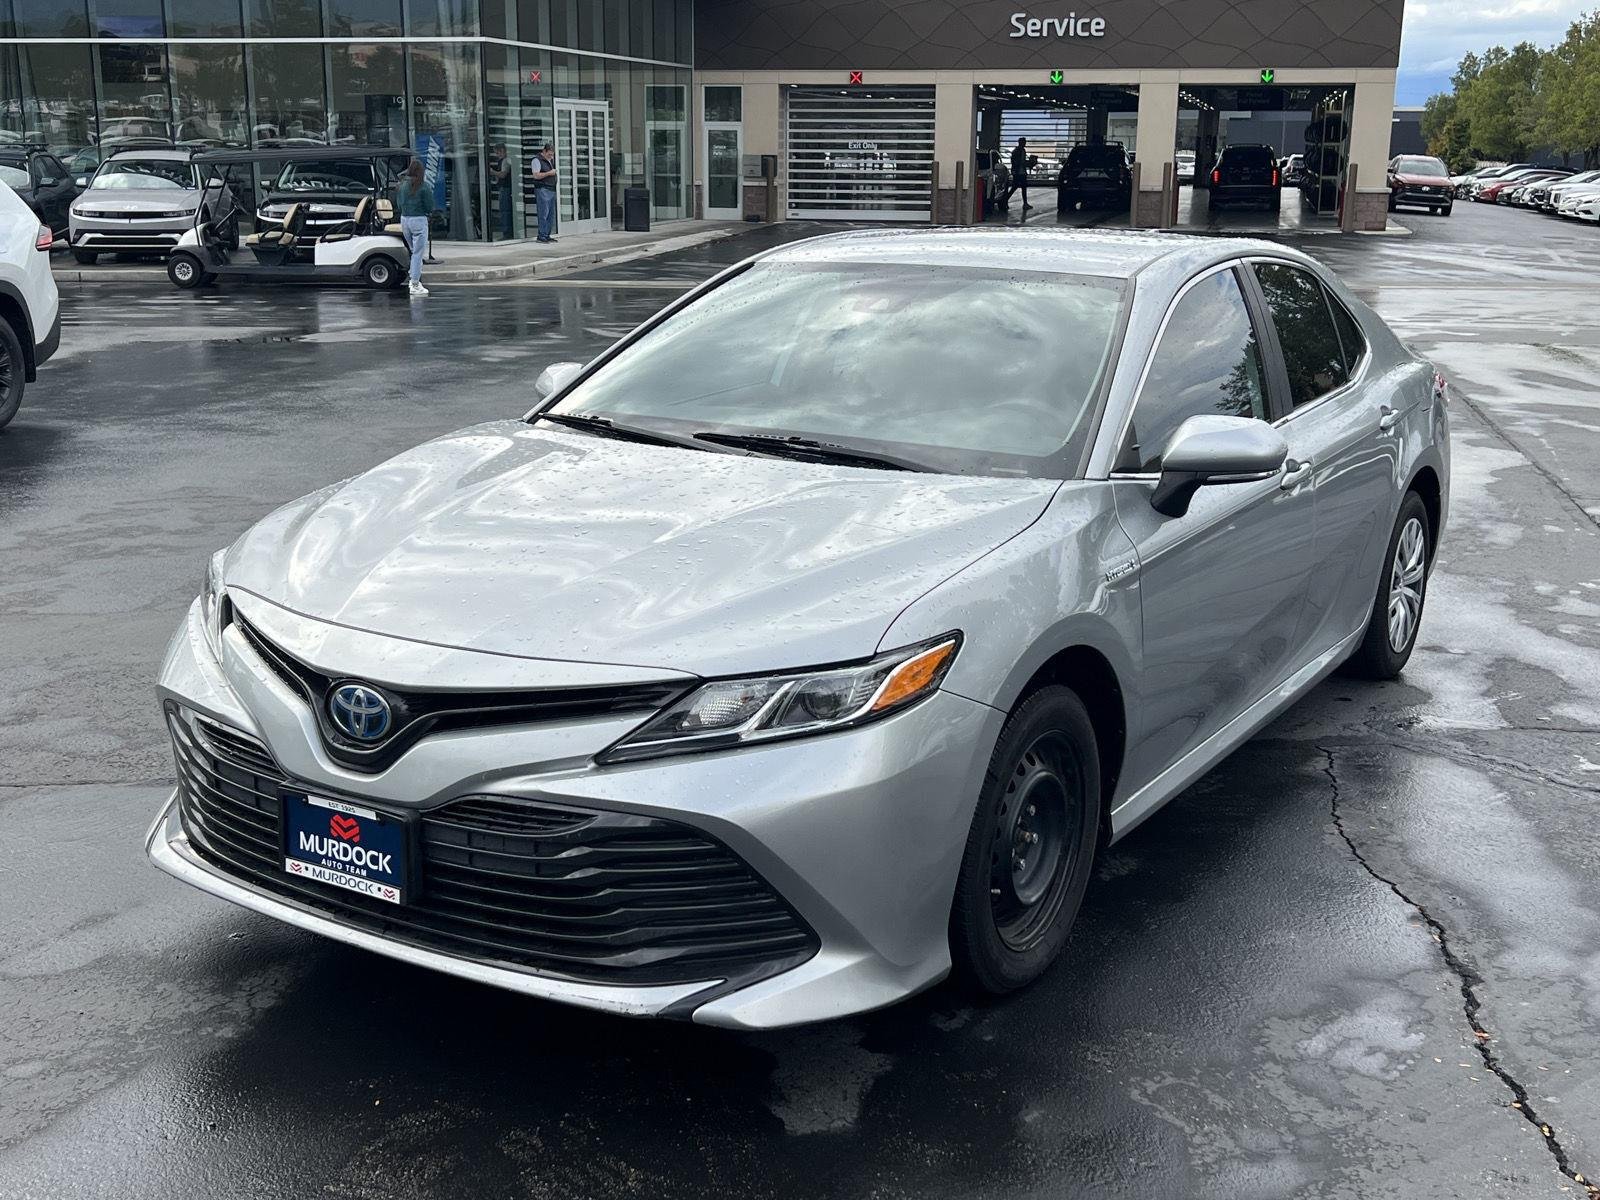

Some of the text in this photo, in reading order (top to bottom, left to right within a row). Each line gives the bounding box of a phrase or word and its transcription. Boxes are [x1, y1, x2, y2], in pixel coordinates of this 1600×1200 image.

[1009, 12, 1106, 37] Service
[848, 141, 878, 151] Exit Only
[299, 830, 393, 874] MURDOCK
[312, 866, 374, 894] MURDOCK
[321, 858, 367, 877] AUTO TEAM
